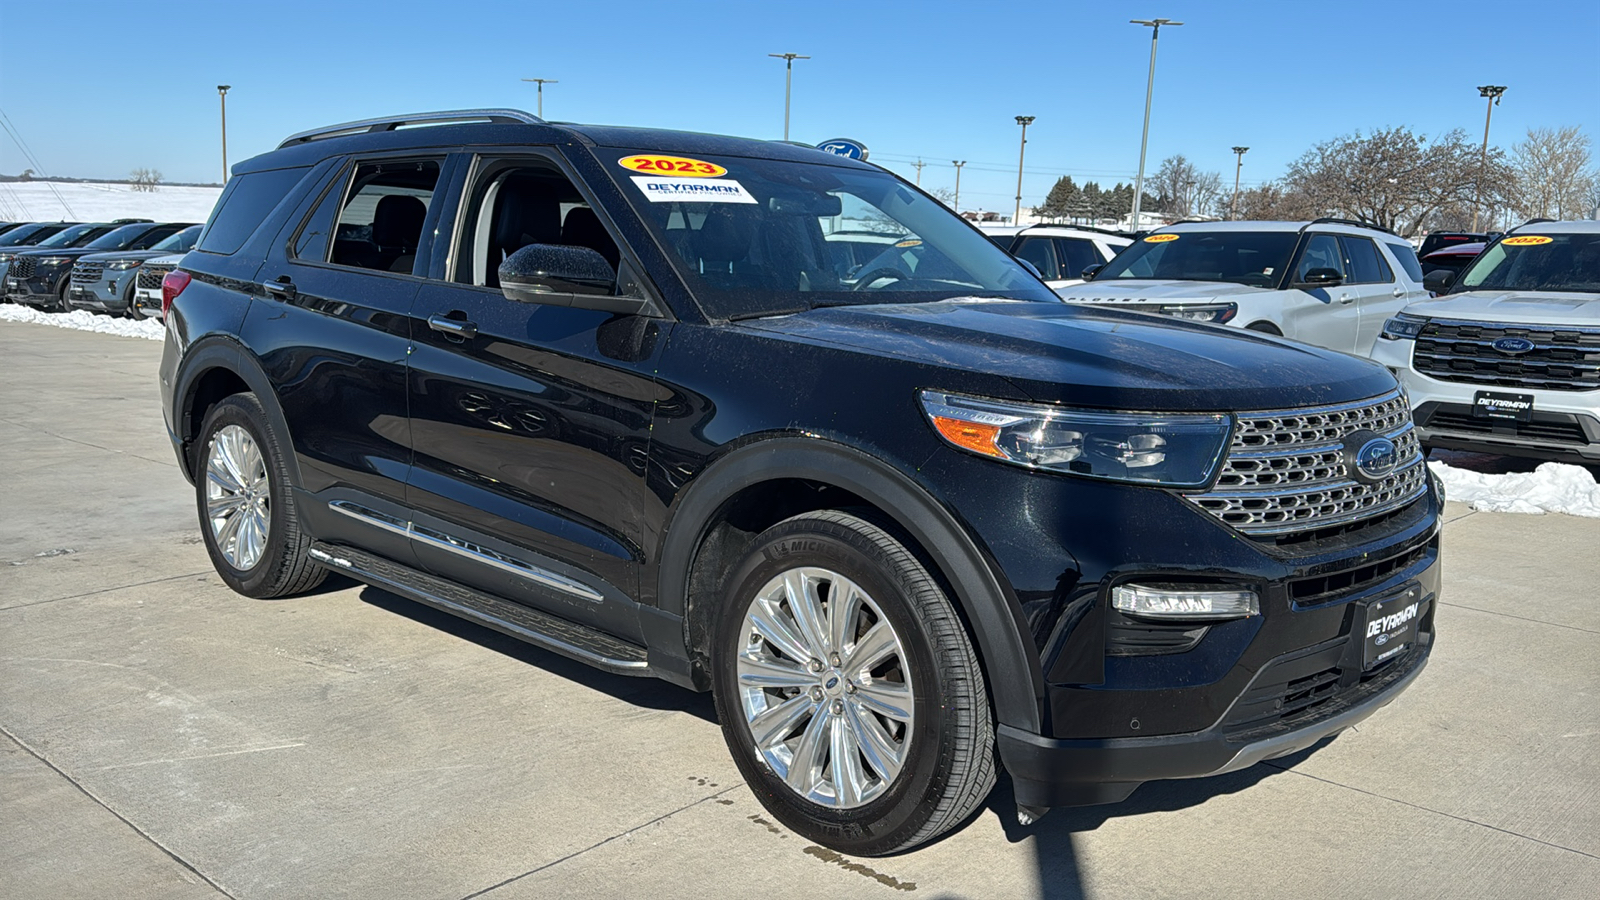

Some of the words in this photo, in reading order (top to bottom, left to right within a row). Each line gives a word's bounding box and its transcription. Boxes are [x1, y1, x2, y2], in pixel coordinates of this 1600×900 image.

[825, 145, 853, 158] Fd
[633, 158, 718, 174] 2023
[647, 183, 739, 193] DEYARMAN
[1499, 340, 1524, 349] Ford
[1477, 398, 1530, 409] DEYARMAN
[1366, 602, 1419, 639] DEYARMAN
